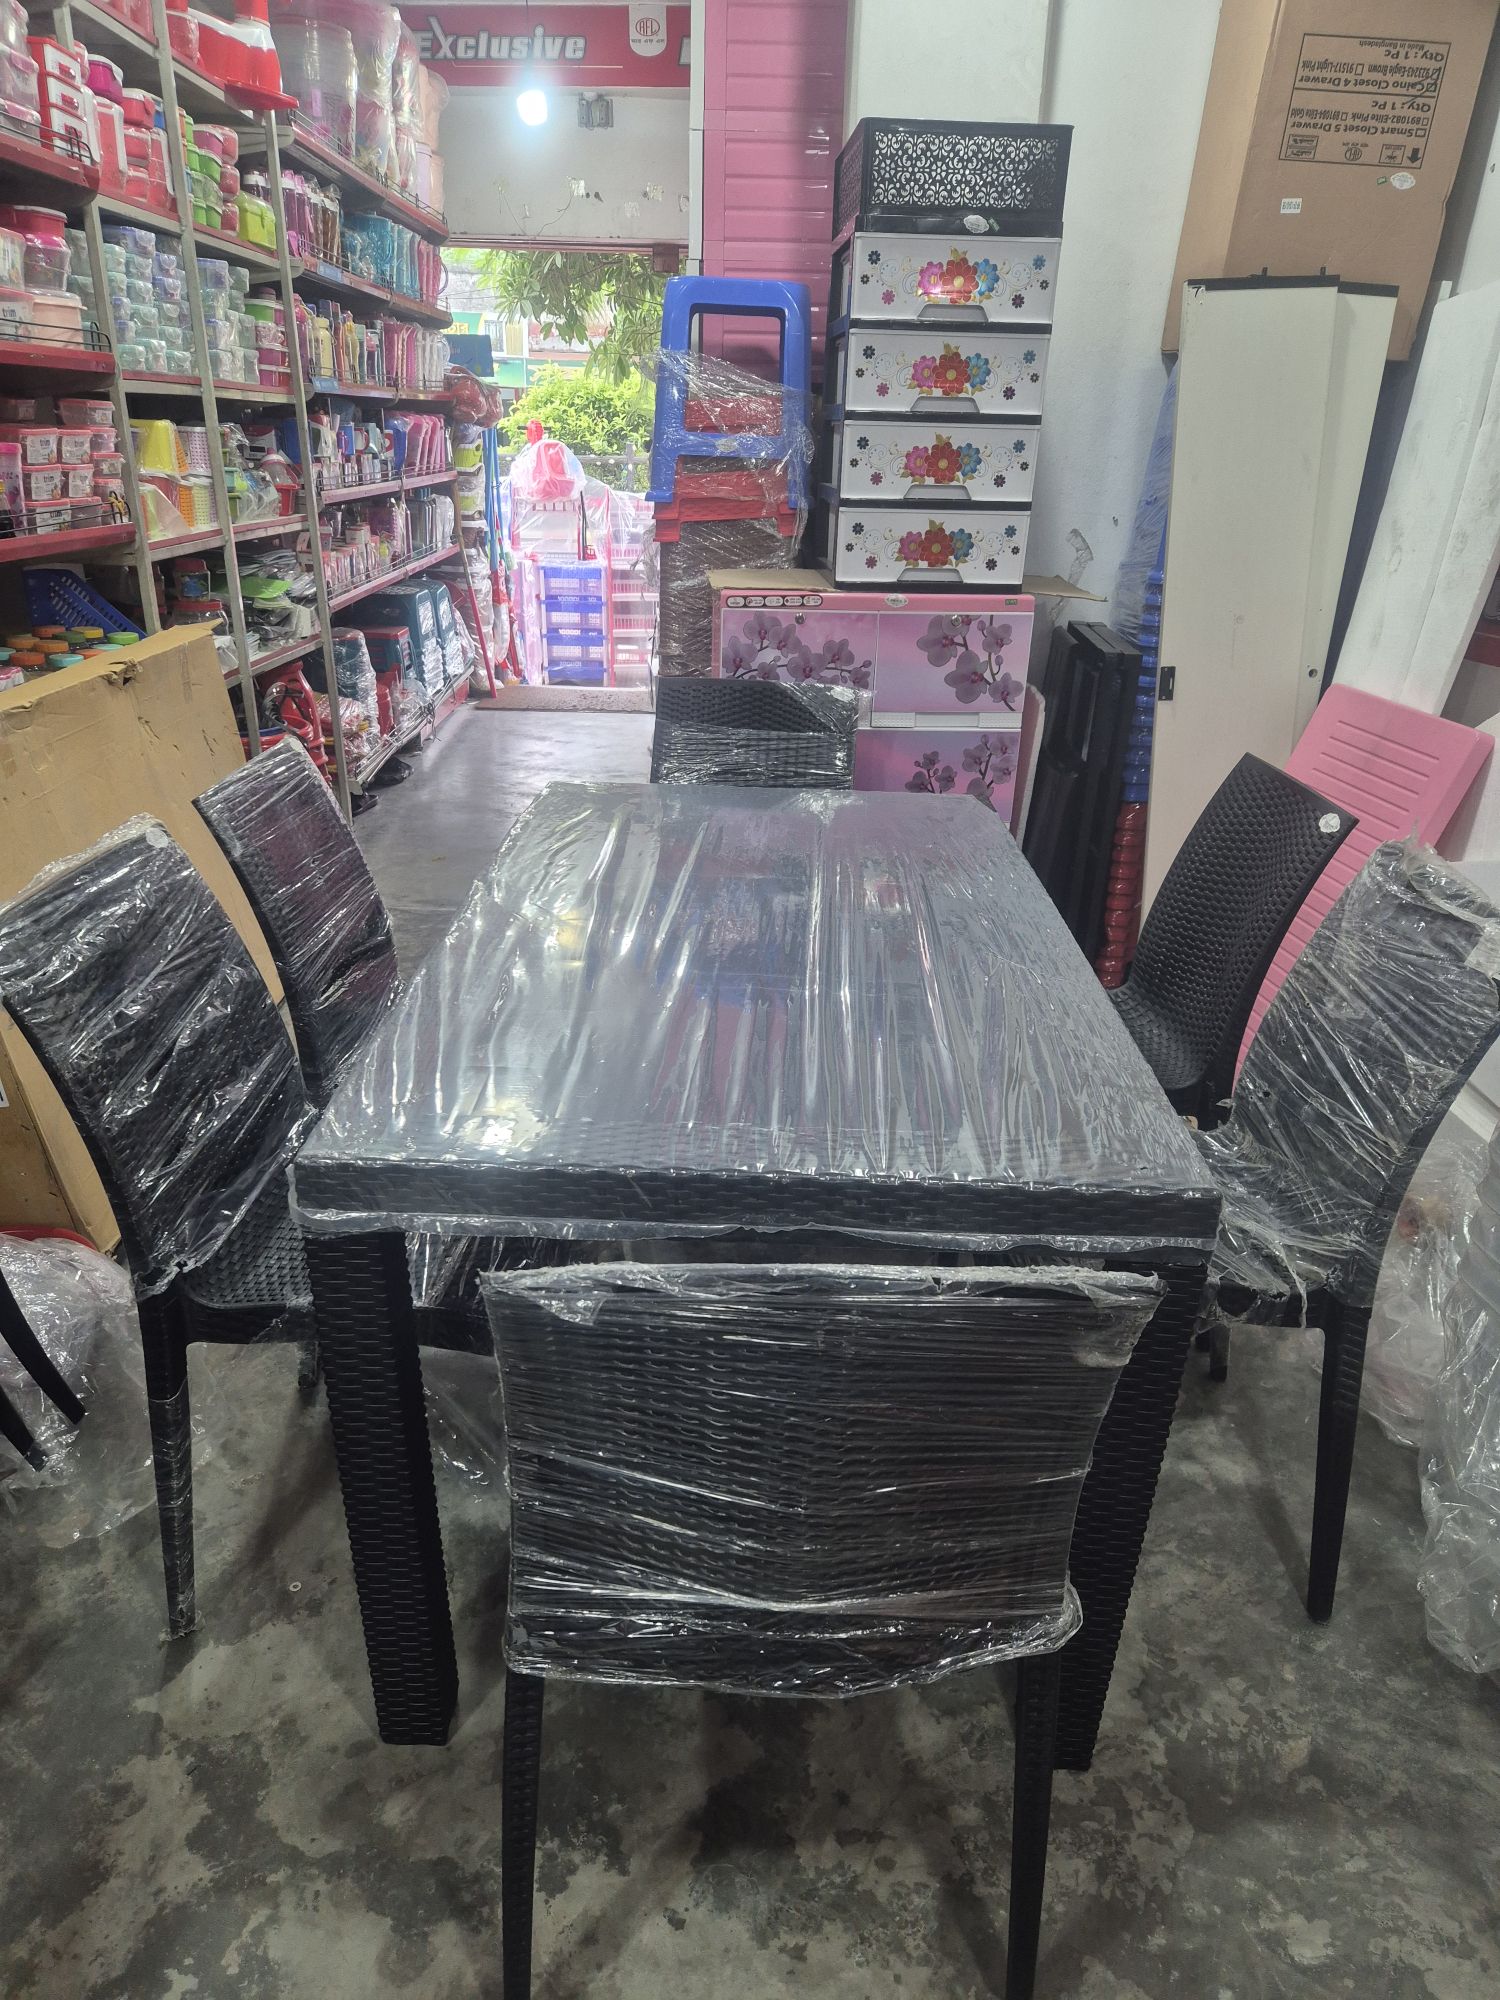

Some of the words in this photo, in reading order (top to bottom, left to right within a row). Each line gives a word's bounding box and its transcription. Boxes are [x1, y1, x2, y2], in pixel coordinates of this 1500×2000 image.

[1359, 40, 1398, 49] Bangladesh
[1384, 50, 1400, 60] Pc
[1301, 60, 1317, 71] Pink
[1298, 75, 1341, 86] Drawer
[1343, 78, 1351, 87] 4
[1353, 79, 1389, 90] Closet
[1392, 81, 1425, 92] Caino
[1371, 101, 1387, 110] Pc
[1350, 112, 1369, 122] Pink
[1290, 121, 1332, 132] Drawer
[1334, 124, 1341, 132] 5
[1343, 124, 1378, 135] Closet
[1381, 126, 1415, 137] Smart
